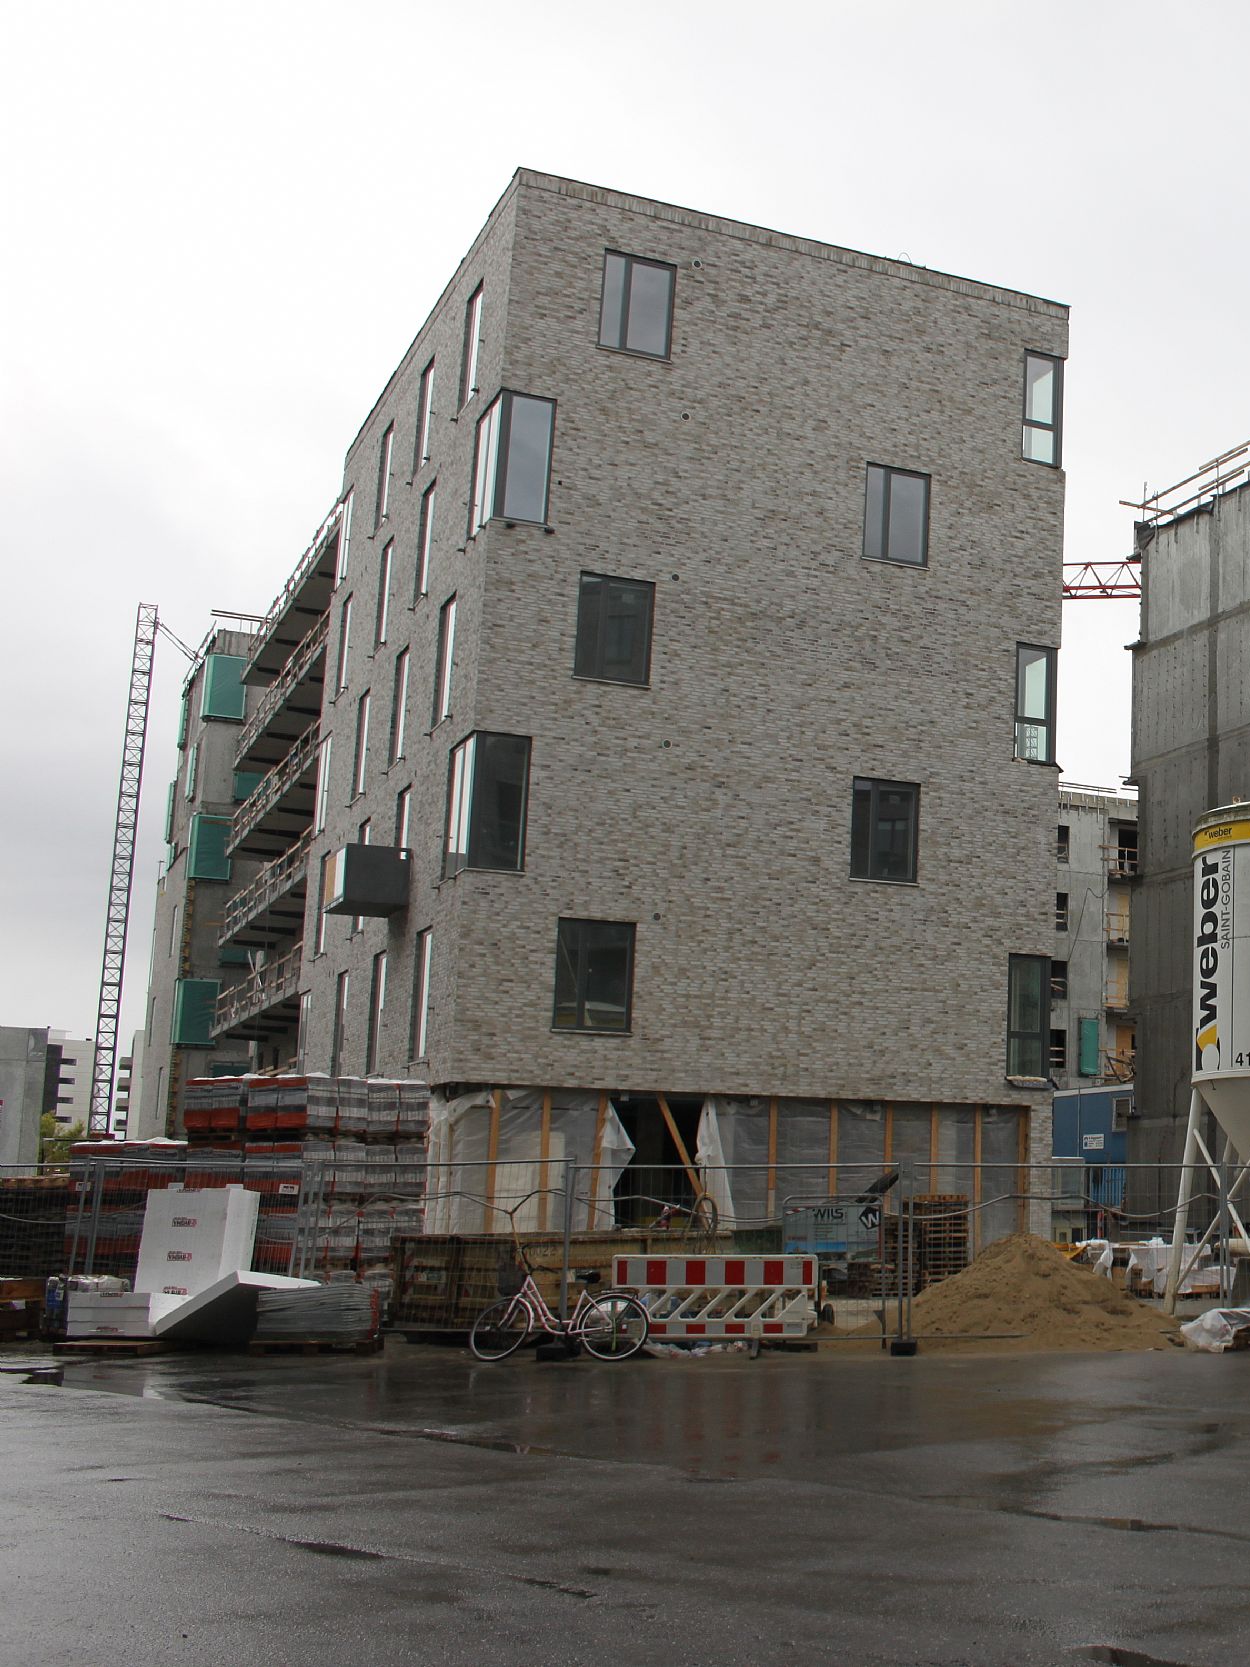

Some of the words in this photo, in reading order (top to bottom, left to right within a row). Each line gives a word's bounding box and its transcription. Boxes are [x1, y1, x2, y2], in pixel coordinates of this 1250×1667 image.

[1208, 827, 1232, 839] weber
[1197, 856, 1220, 1031] weber
[1221, 850, 1231, 949] SAINT-GOBAIN
